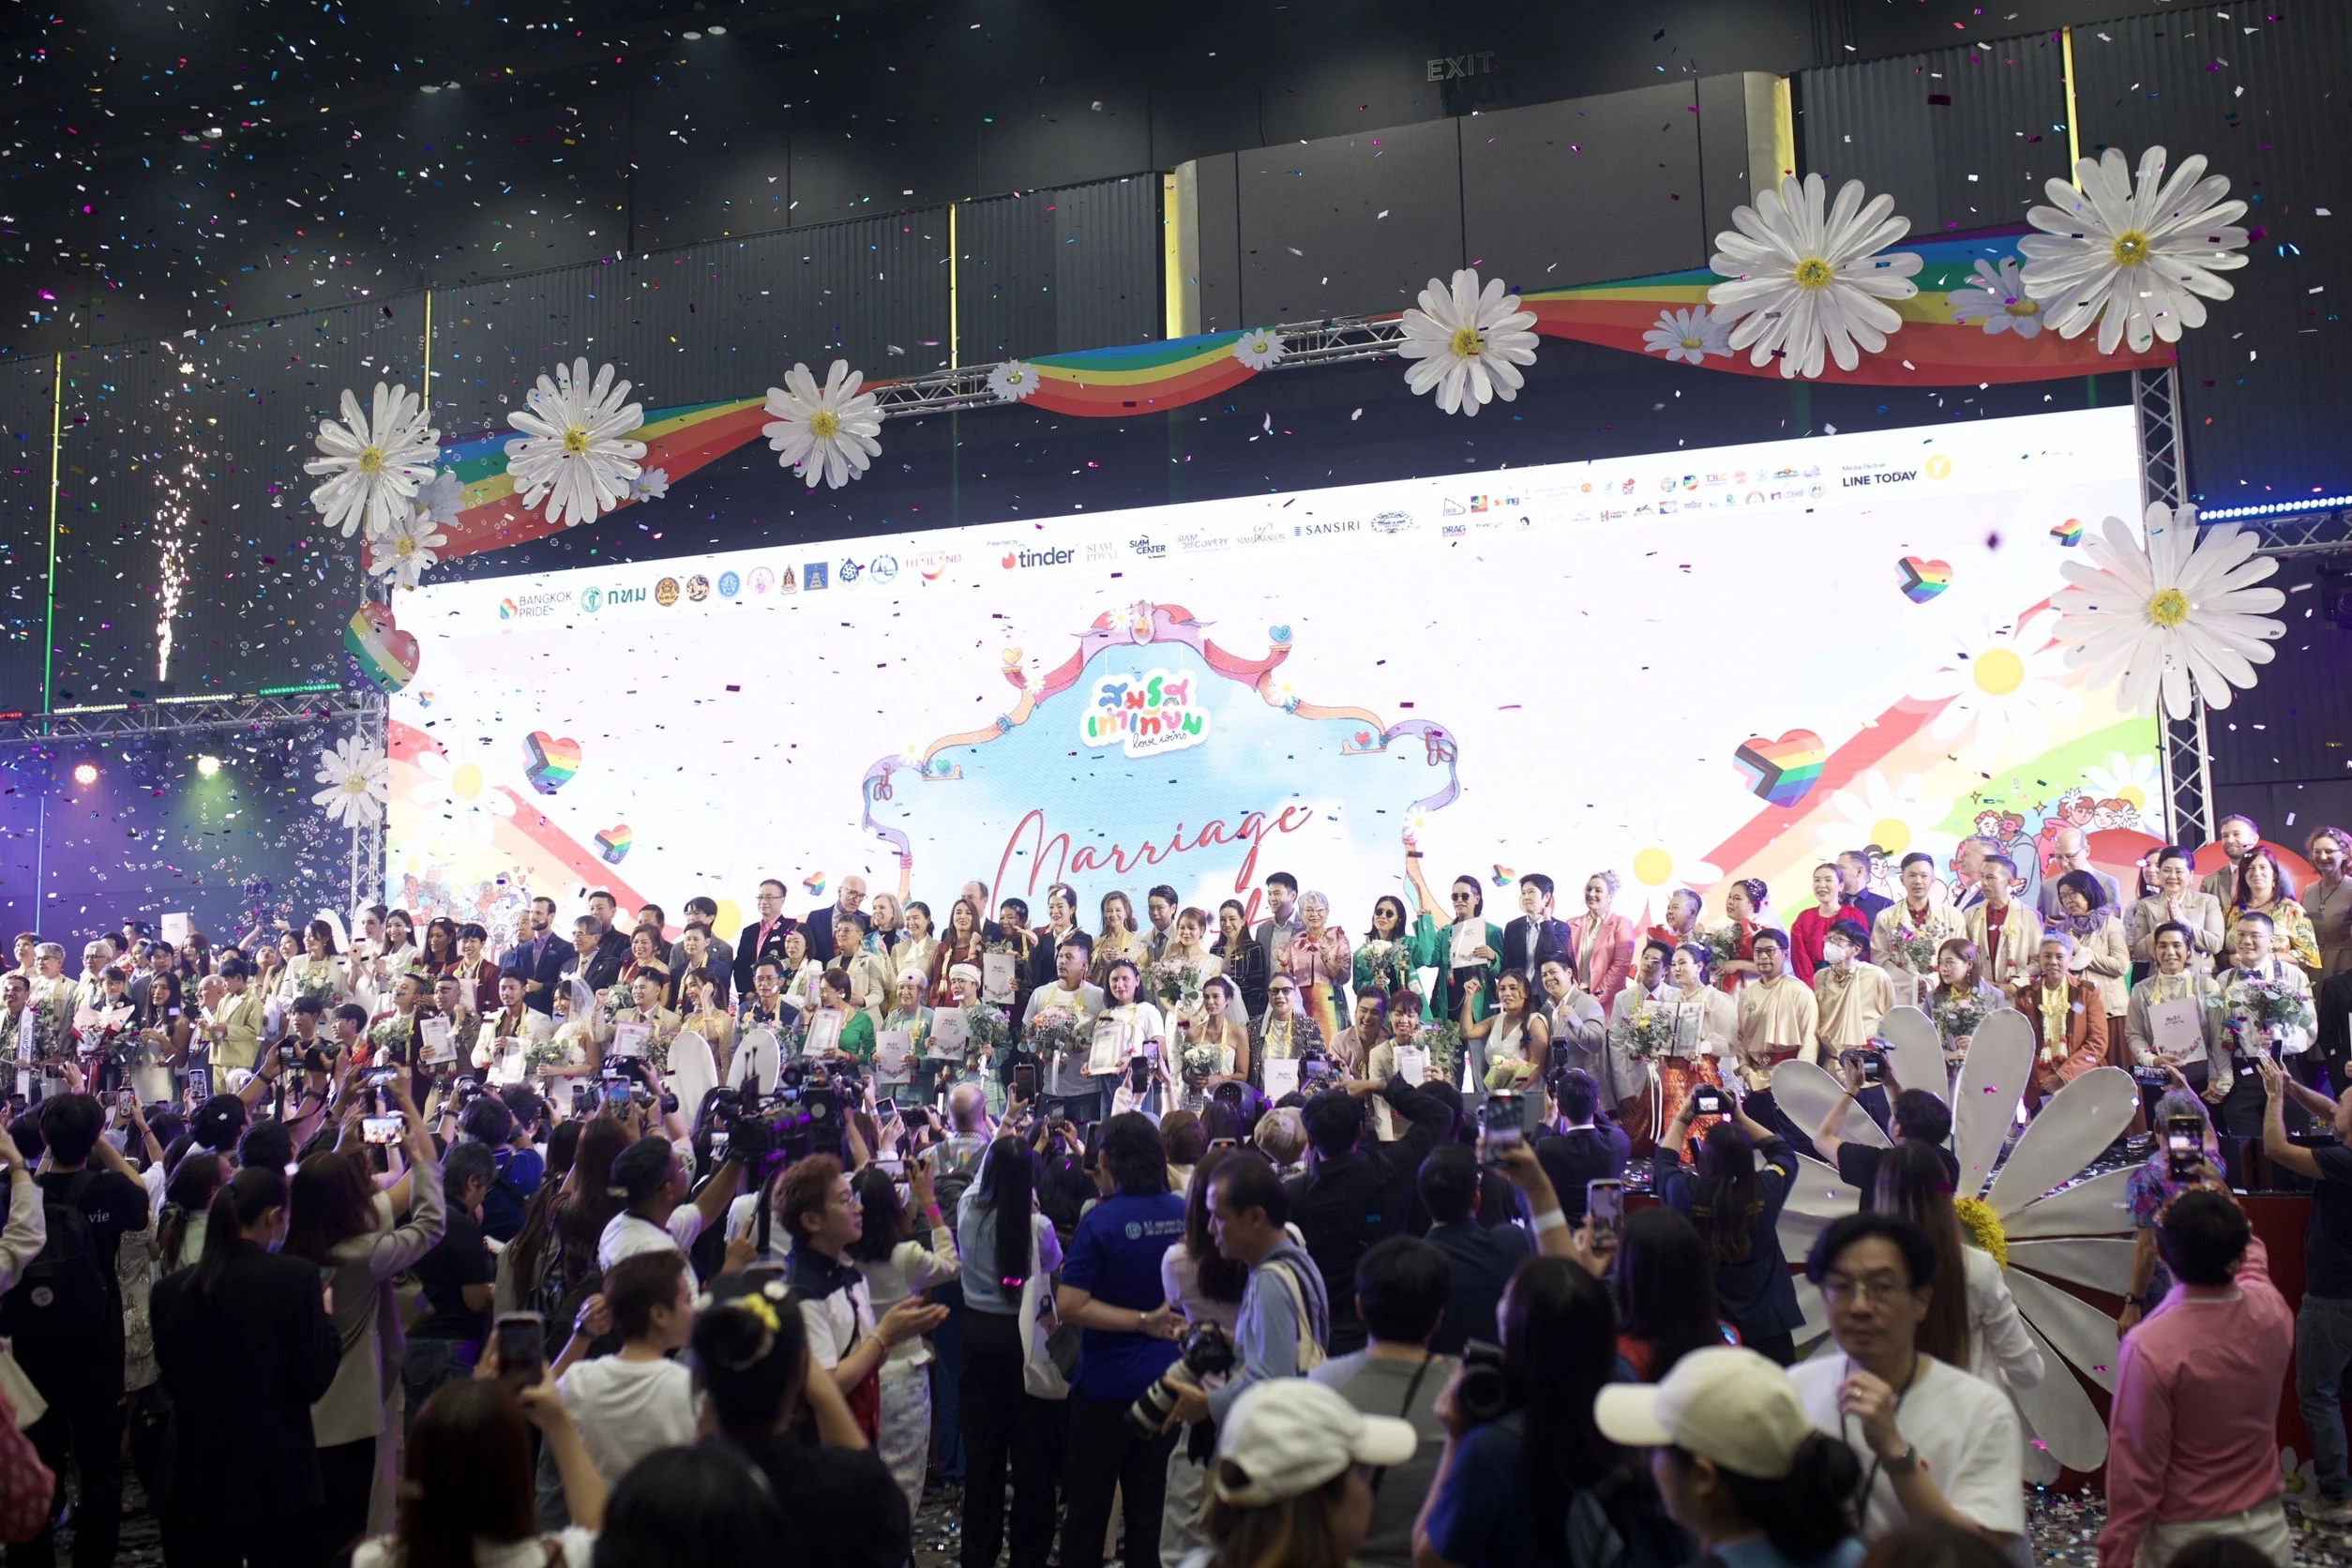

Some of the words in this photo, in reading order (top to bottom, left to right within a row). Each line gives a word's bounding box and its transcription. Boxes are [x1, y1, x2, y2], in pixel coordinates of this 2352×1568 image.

[1426, 51, 1495, 82] EXIT
[1843, 475, 1872, 488] LINE
[1874, 471, 1918, 484] TODAY
[1305, 520, 1361, 535] SANSIRI
[1442, 524, 1467, 535] DRAG
[1129, 538, 1151, 549] SIAM
[1177, 534, 1199, 543] SIAM
[1182, 537, 1229, 550] DISCOVERY
[1086, 543, 1114, 553] SIAM
[1136, 544, 1167, 555] CENTER
[1018, 547, 1076, 568] tinder
[519, 591, 573, 607] BANGKOK
[608, 587, 647, 605] กทม
[519, 606, 550, 618] PRIDE
[1132, 732, 1158, 748] love
[1159, 730, 1187, 745] wins
[989, 806, 1313, 922] Marriage
